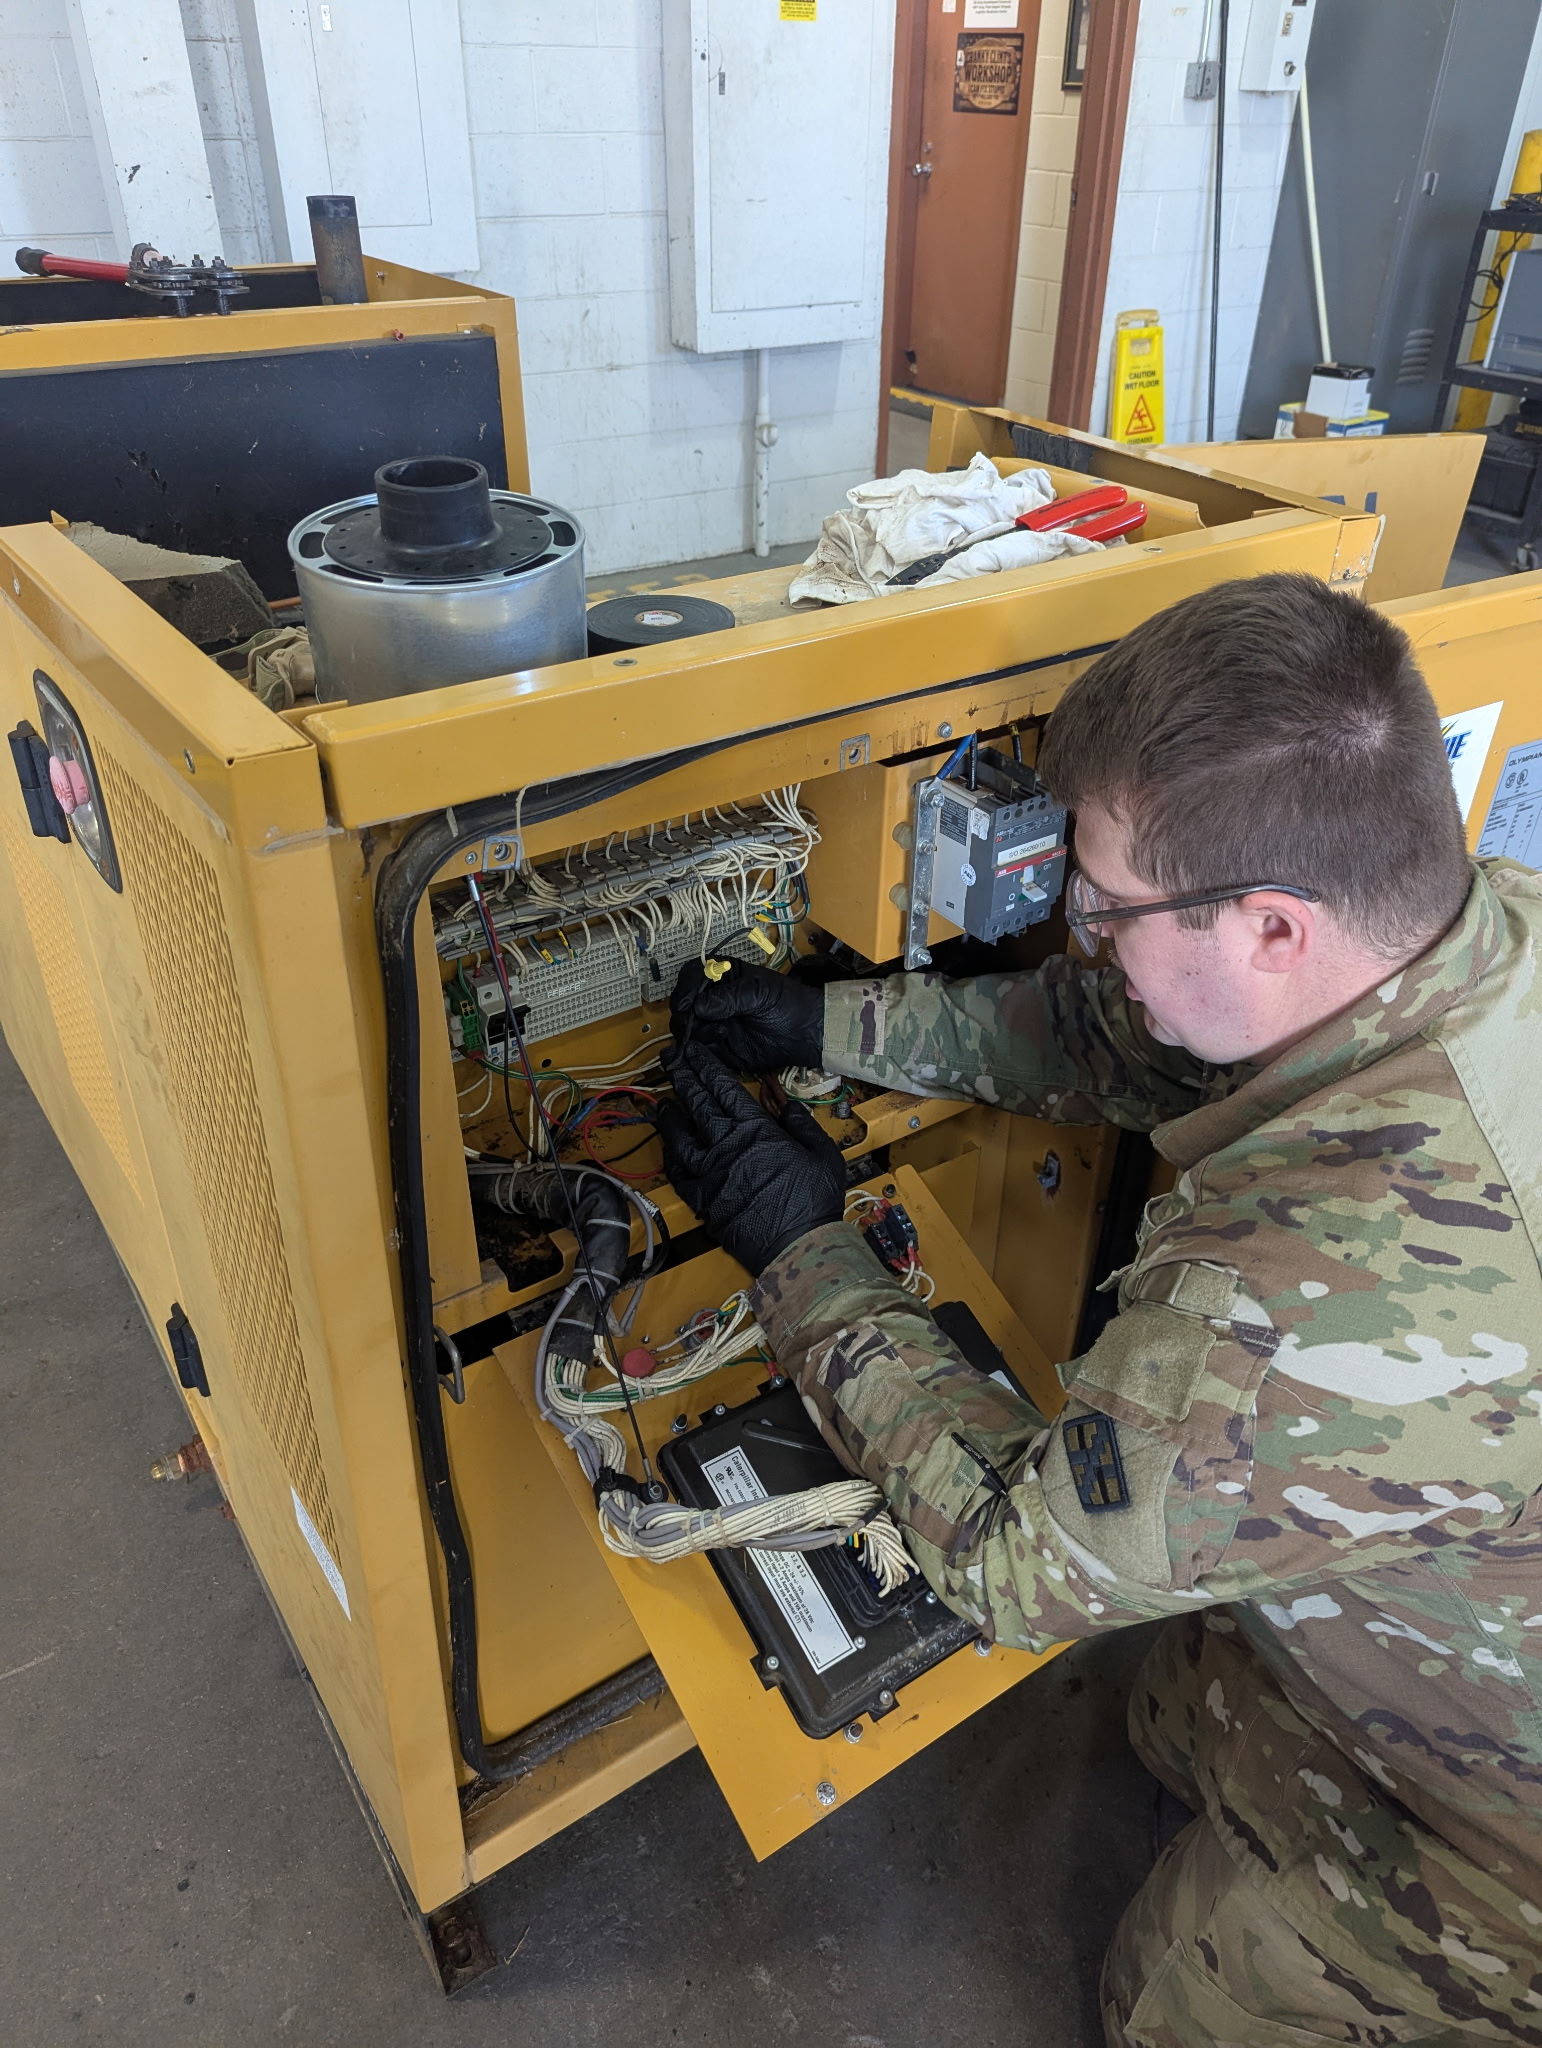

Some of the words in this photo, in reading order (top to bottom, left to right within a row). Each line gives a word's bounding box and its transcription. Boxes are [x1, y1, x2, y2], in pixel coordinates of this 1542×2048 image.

[965, 64, 1011, 83] WORKSHOP
[1129, 370, 1156, 380] CAUTION
[1124, 382, 1137, 391] WET
[1139, 380, 1159, 389] FLOOR
[731, 1455, 753, 1489] Caterpillar
